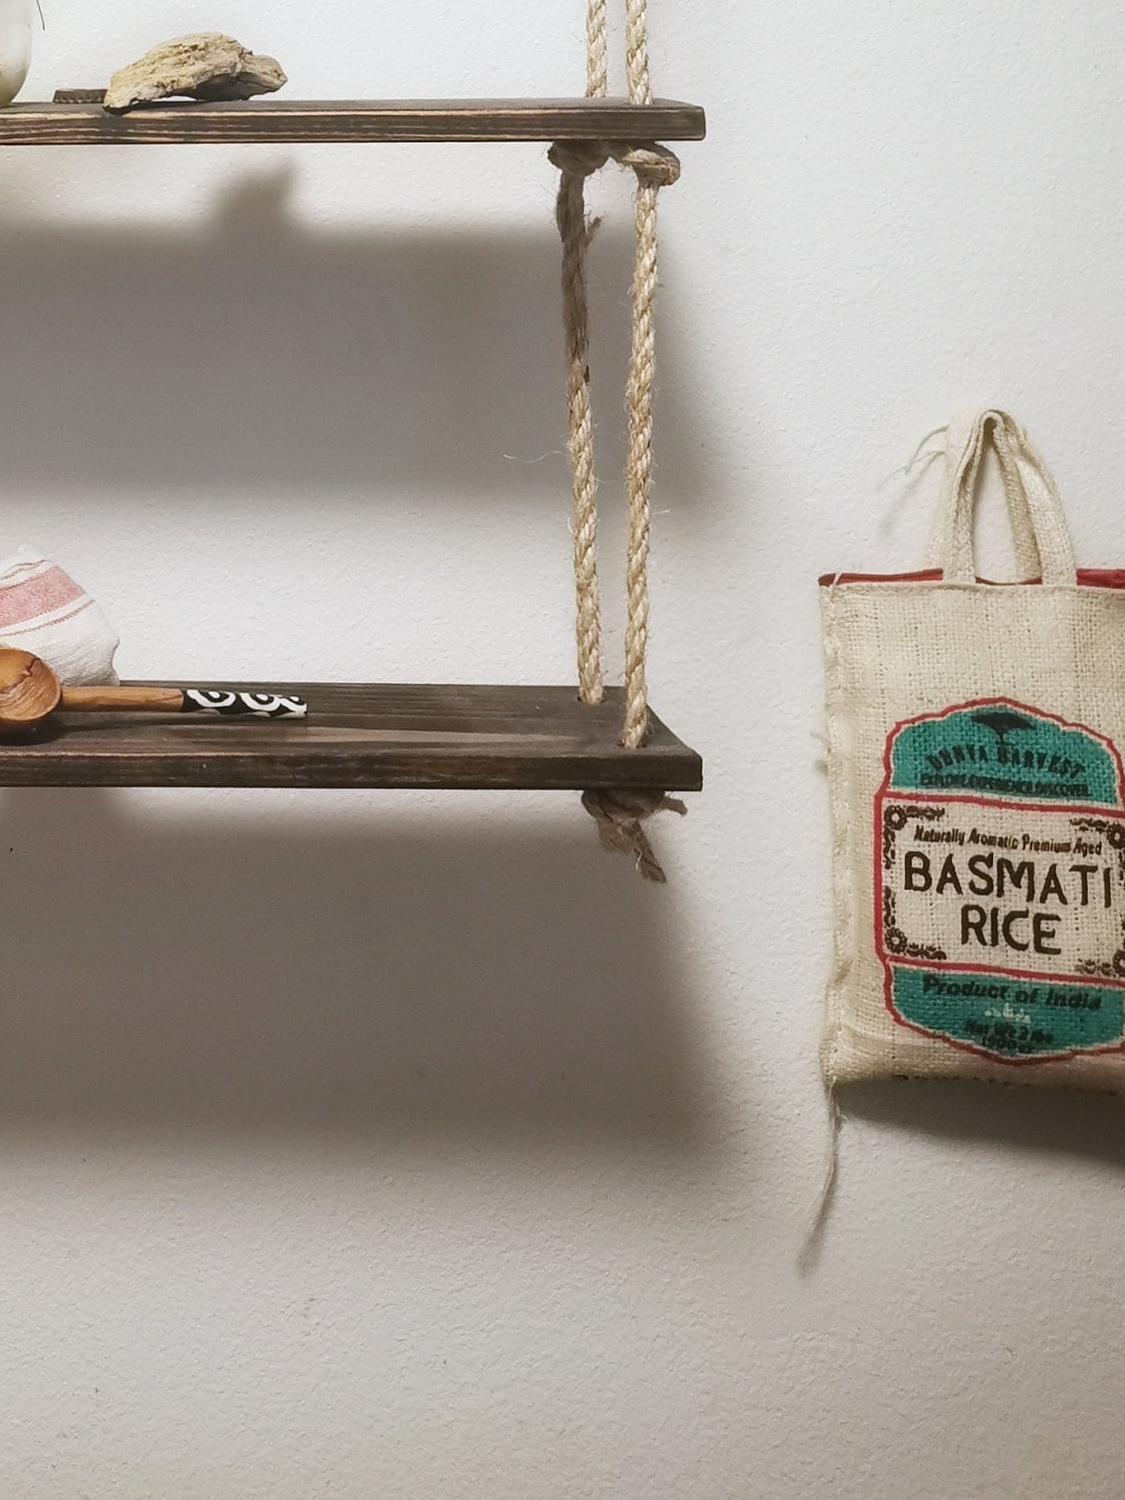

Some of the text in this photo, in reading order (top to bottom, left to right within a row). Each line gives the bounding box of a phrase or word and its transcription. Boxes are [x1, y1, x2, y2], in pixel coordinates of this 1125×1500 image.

[996, 744, 1086, 780] HARVEST
[913, 824, 1103, 858] Naturally Aromatic Premium Aged
[904, 850, 1112, 908] BASMATI
[961, 904, 1062, 955] RICE
[923, 973, 1103, 1009] Product of India
